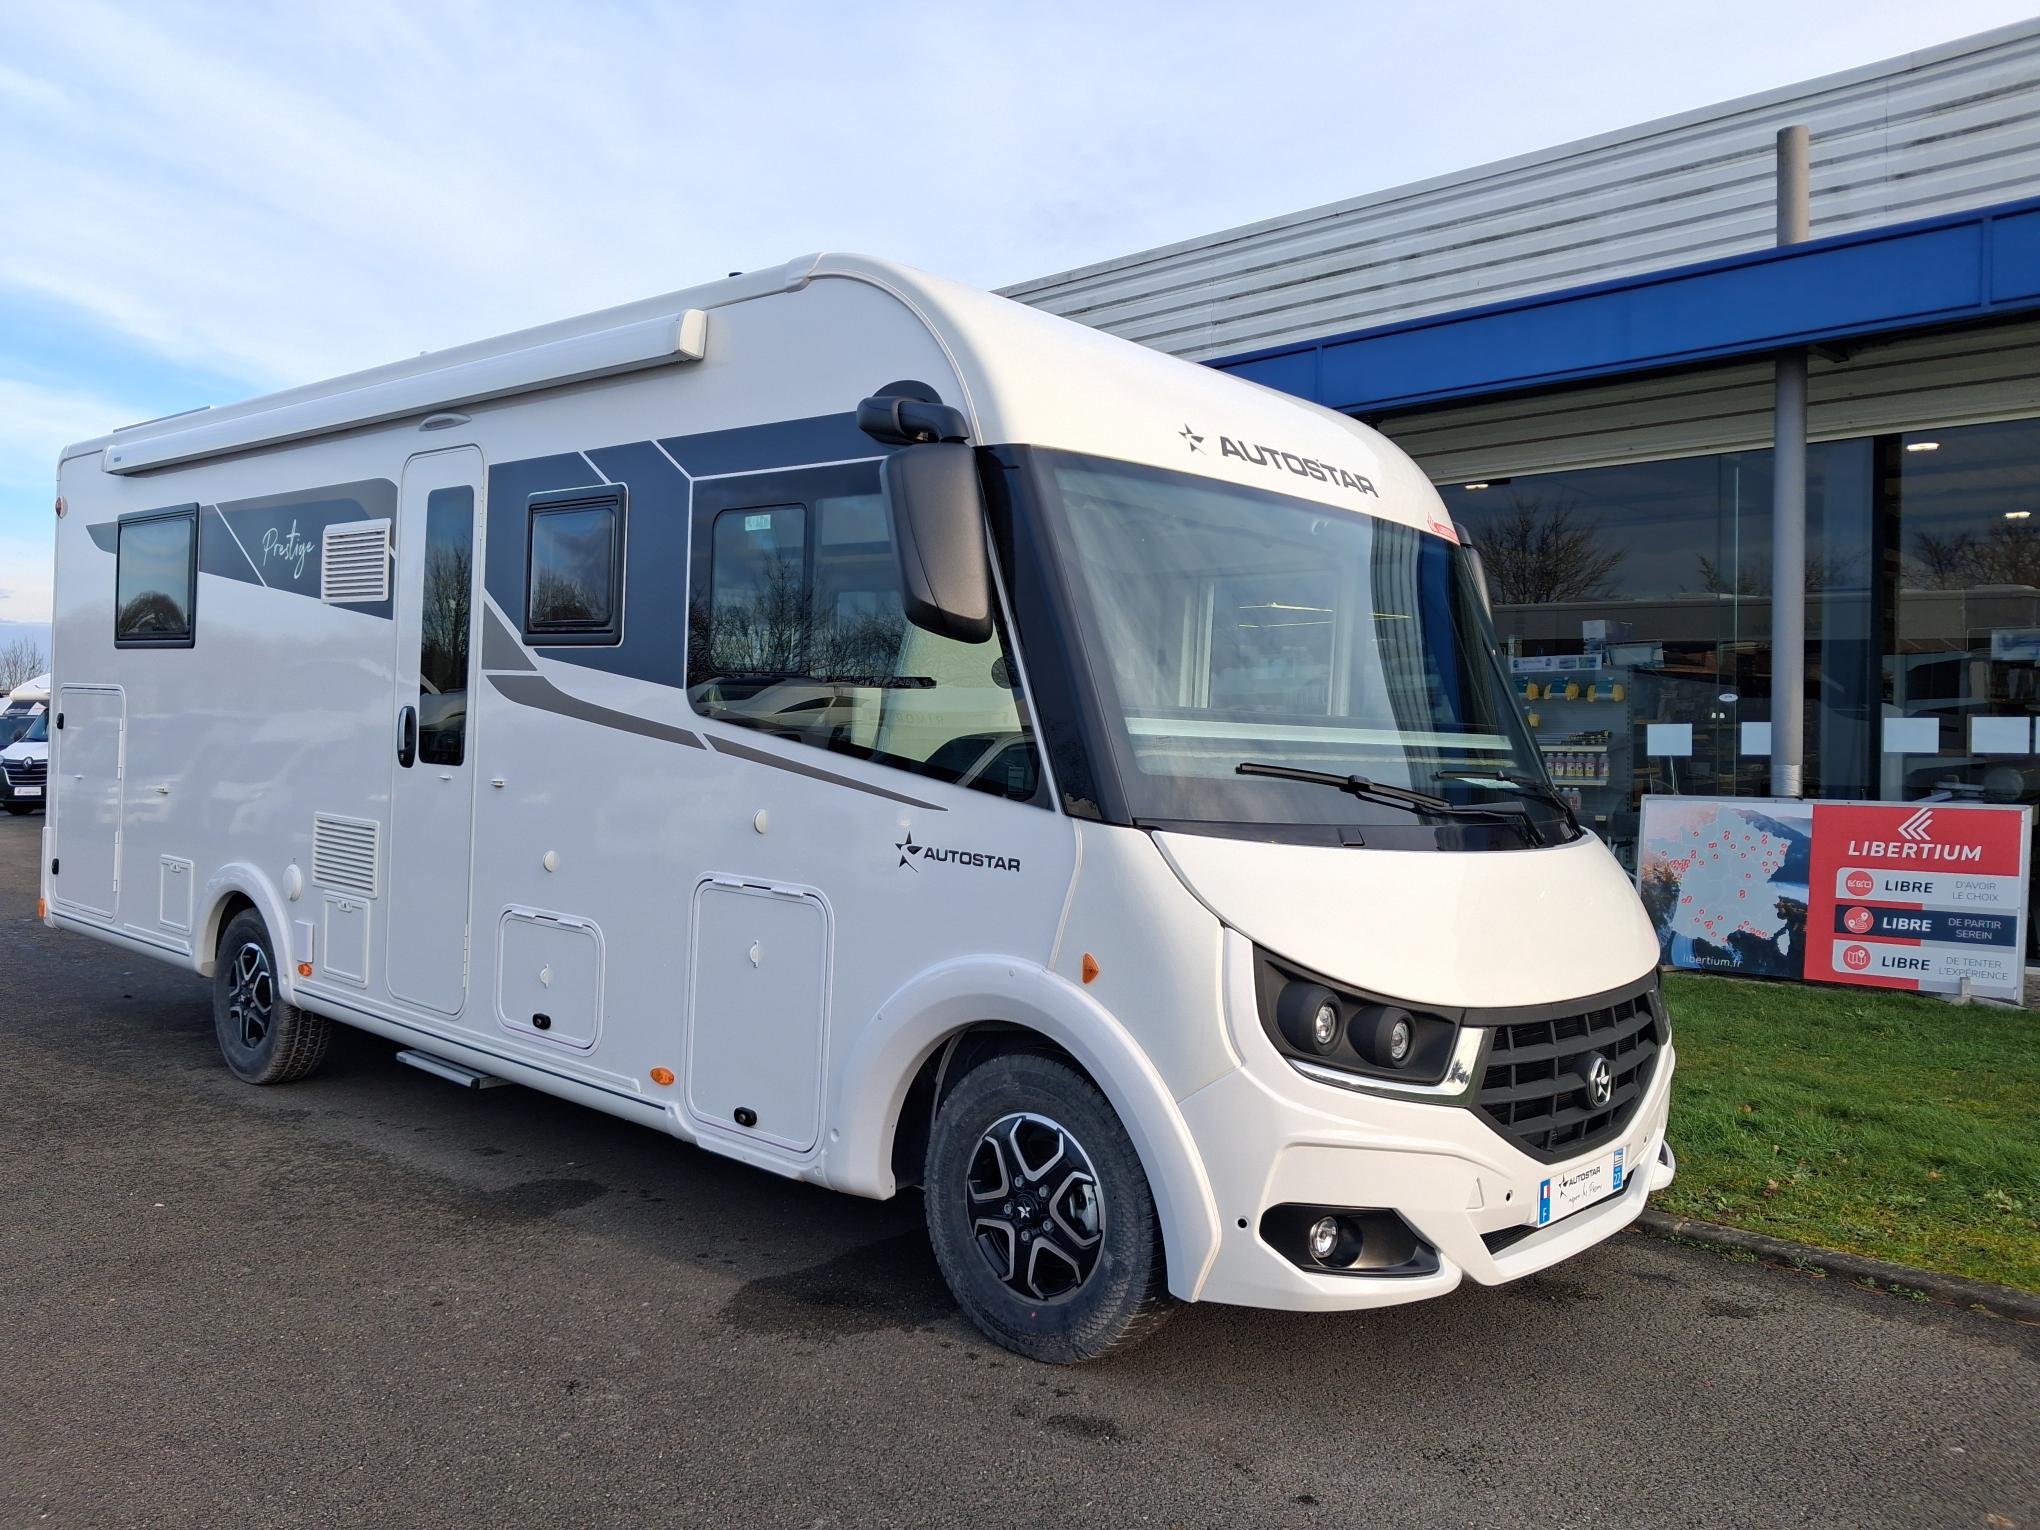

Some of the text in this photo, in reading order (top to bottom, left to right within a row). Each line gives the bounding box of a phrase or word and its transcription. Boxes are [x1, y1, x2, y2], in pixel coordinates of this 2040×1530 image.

[1219, 435, 1379, 498] AUTOSTAR
[262, 519, 315, 580] Prestige
[1848, 840, 1983, 862] LIBERTIUM
[923, 847, 1021, 873] AUTOSTAR
[1884, 880, 1934, 894] LIBRE
[1955, 880, 1997, 891] D'AVOIR
[1952, 891, 1999, 902] LE CHOIX
[1882, 916, 1933, 932] LIBRE
[1948, 918, 2002, 930] DE PARTIR
[1955, 929, 1993, 940] SEREIN
[1683, 953, 1742, 968] libertium.fr
[1881, 955, 1931, 971] LIBRE
[1946, 956, 2002, 969] DE TENTER
[1939, 966, 2008, 981] L'EXPÉRIENCE
[1569, 1166, 1601, 1187] AUTOSTAR
